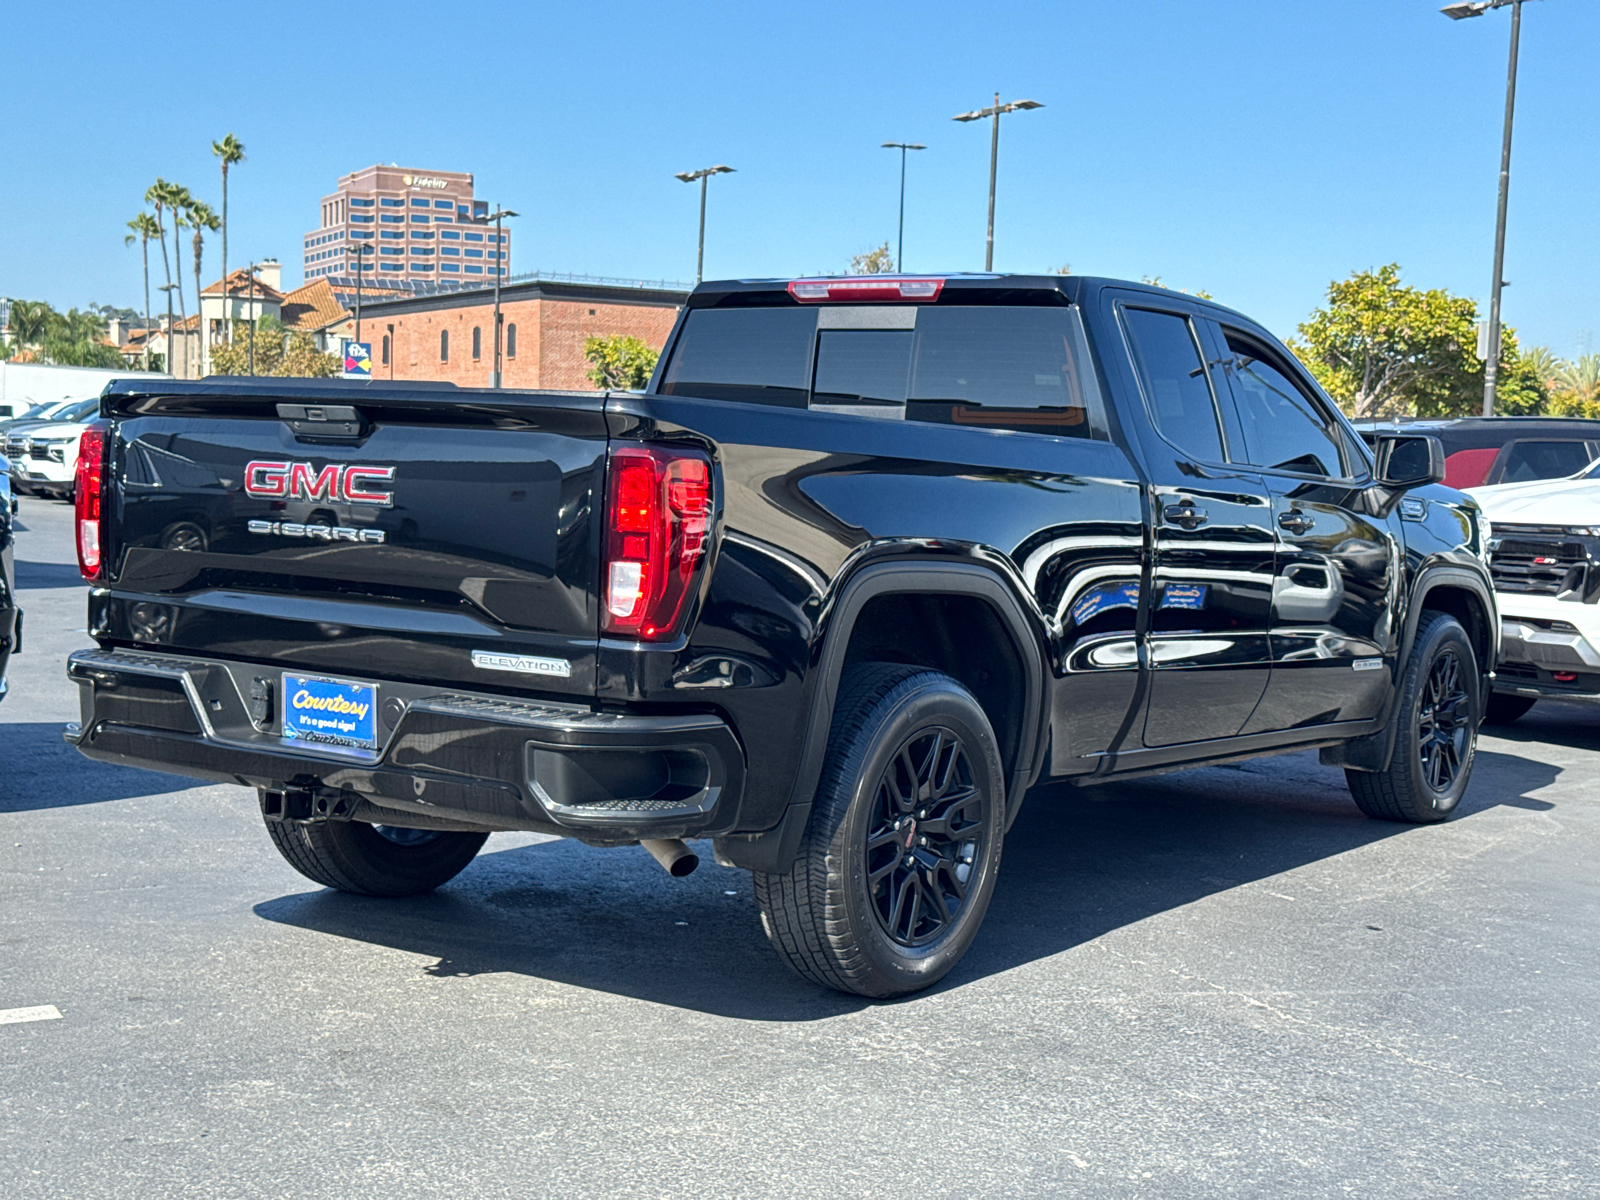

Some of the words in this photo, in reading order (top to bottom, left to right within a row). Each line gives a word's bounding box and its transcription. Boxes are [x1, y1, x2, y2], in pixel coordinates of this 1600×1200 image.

[413, 176, 448, 189] Fidelity
[244, 460, 397, 508] GMC
[247, 519, 387, 544] SIERRA
[479, 655, 564, 673] ELEVATION
[292, 690, 370, 721] Courtesy
[311, 718, 318, 726] a
[317, 719, 338, 729] good
[337, 720, 356, 732] sign!
